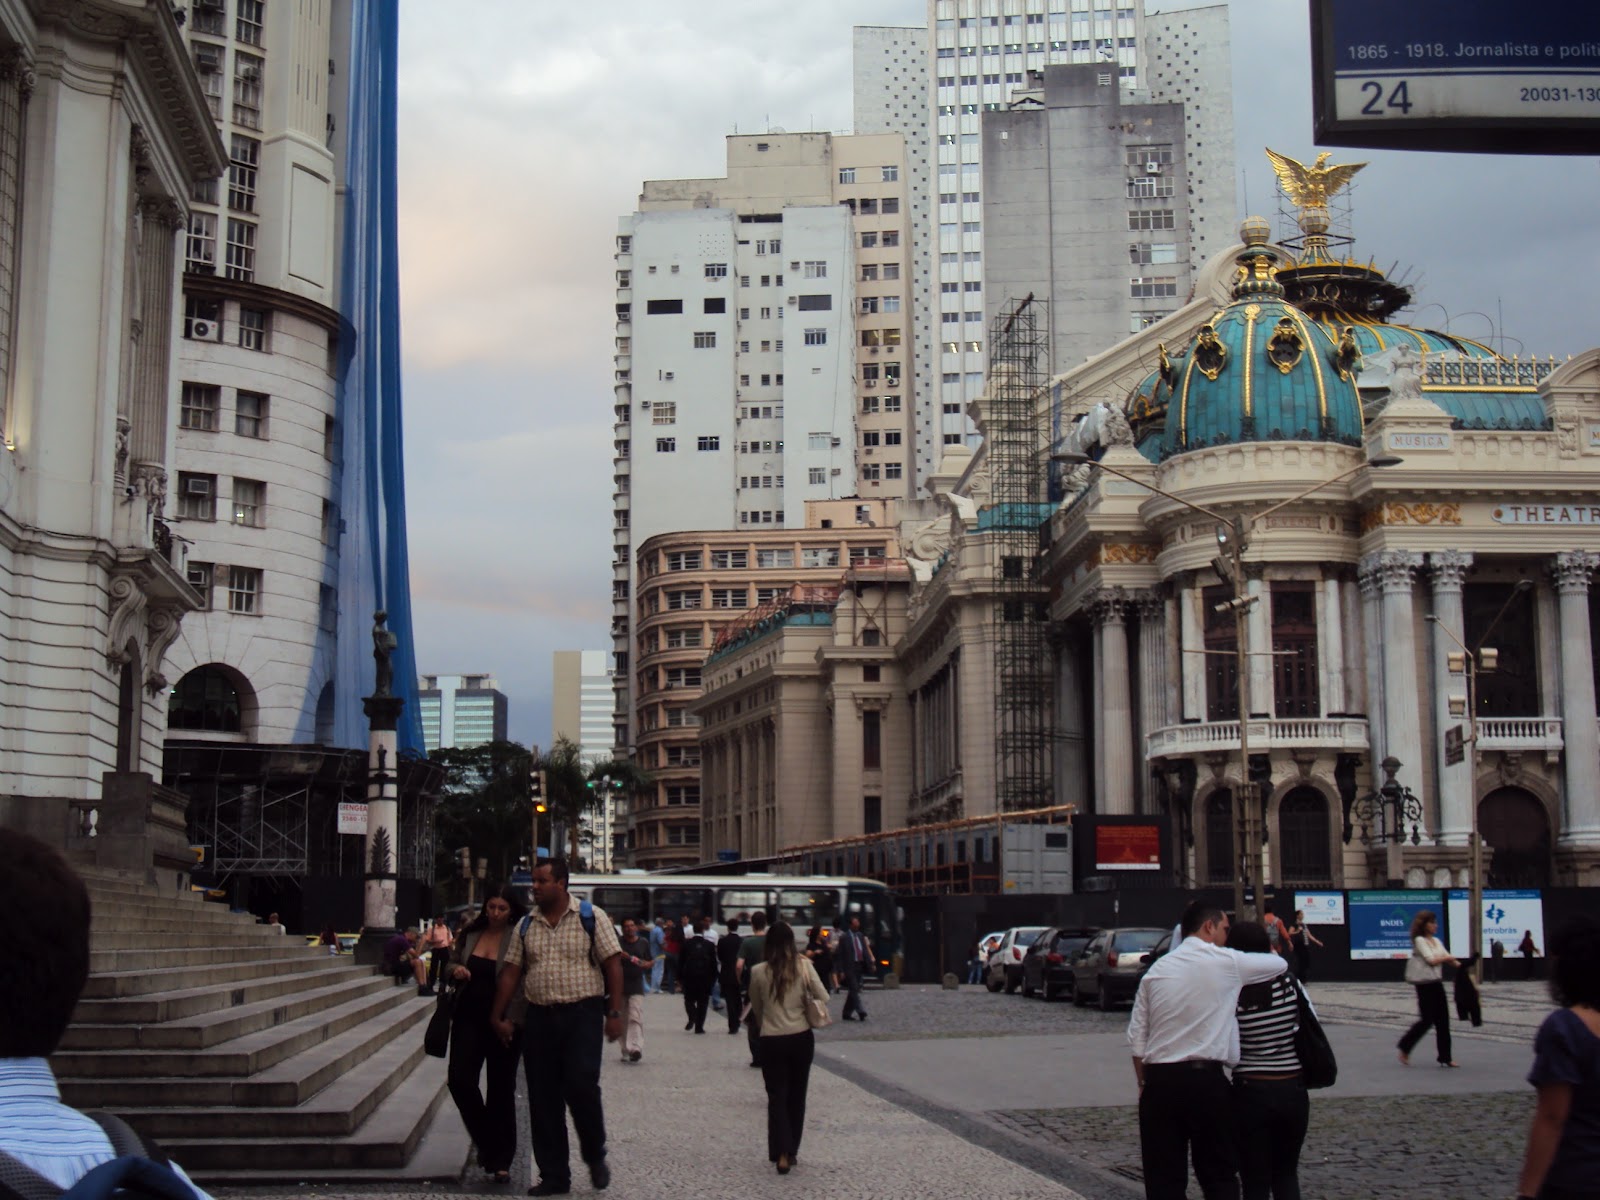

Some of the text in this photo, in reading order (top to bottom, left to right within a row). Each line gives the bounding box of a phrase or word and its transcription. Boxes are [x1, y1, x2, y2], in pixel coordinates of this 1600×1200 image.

[1349, 45, 1388, 60] 1865
[1406, 43, 1449, 58] 1918.
[1454, 42, 1539, 57] Jornalista
[1544, 45, 1554, 56] e
[1361, 81, 1413, 115] 24
[1510, 506, 1600, 522] THEATR
[1380, 919, 1404, 927] BNDES
